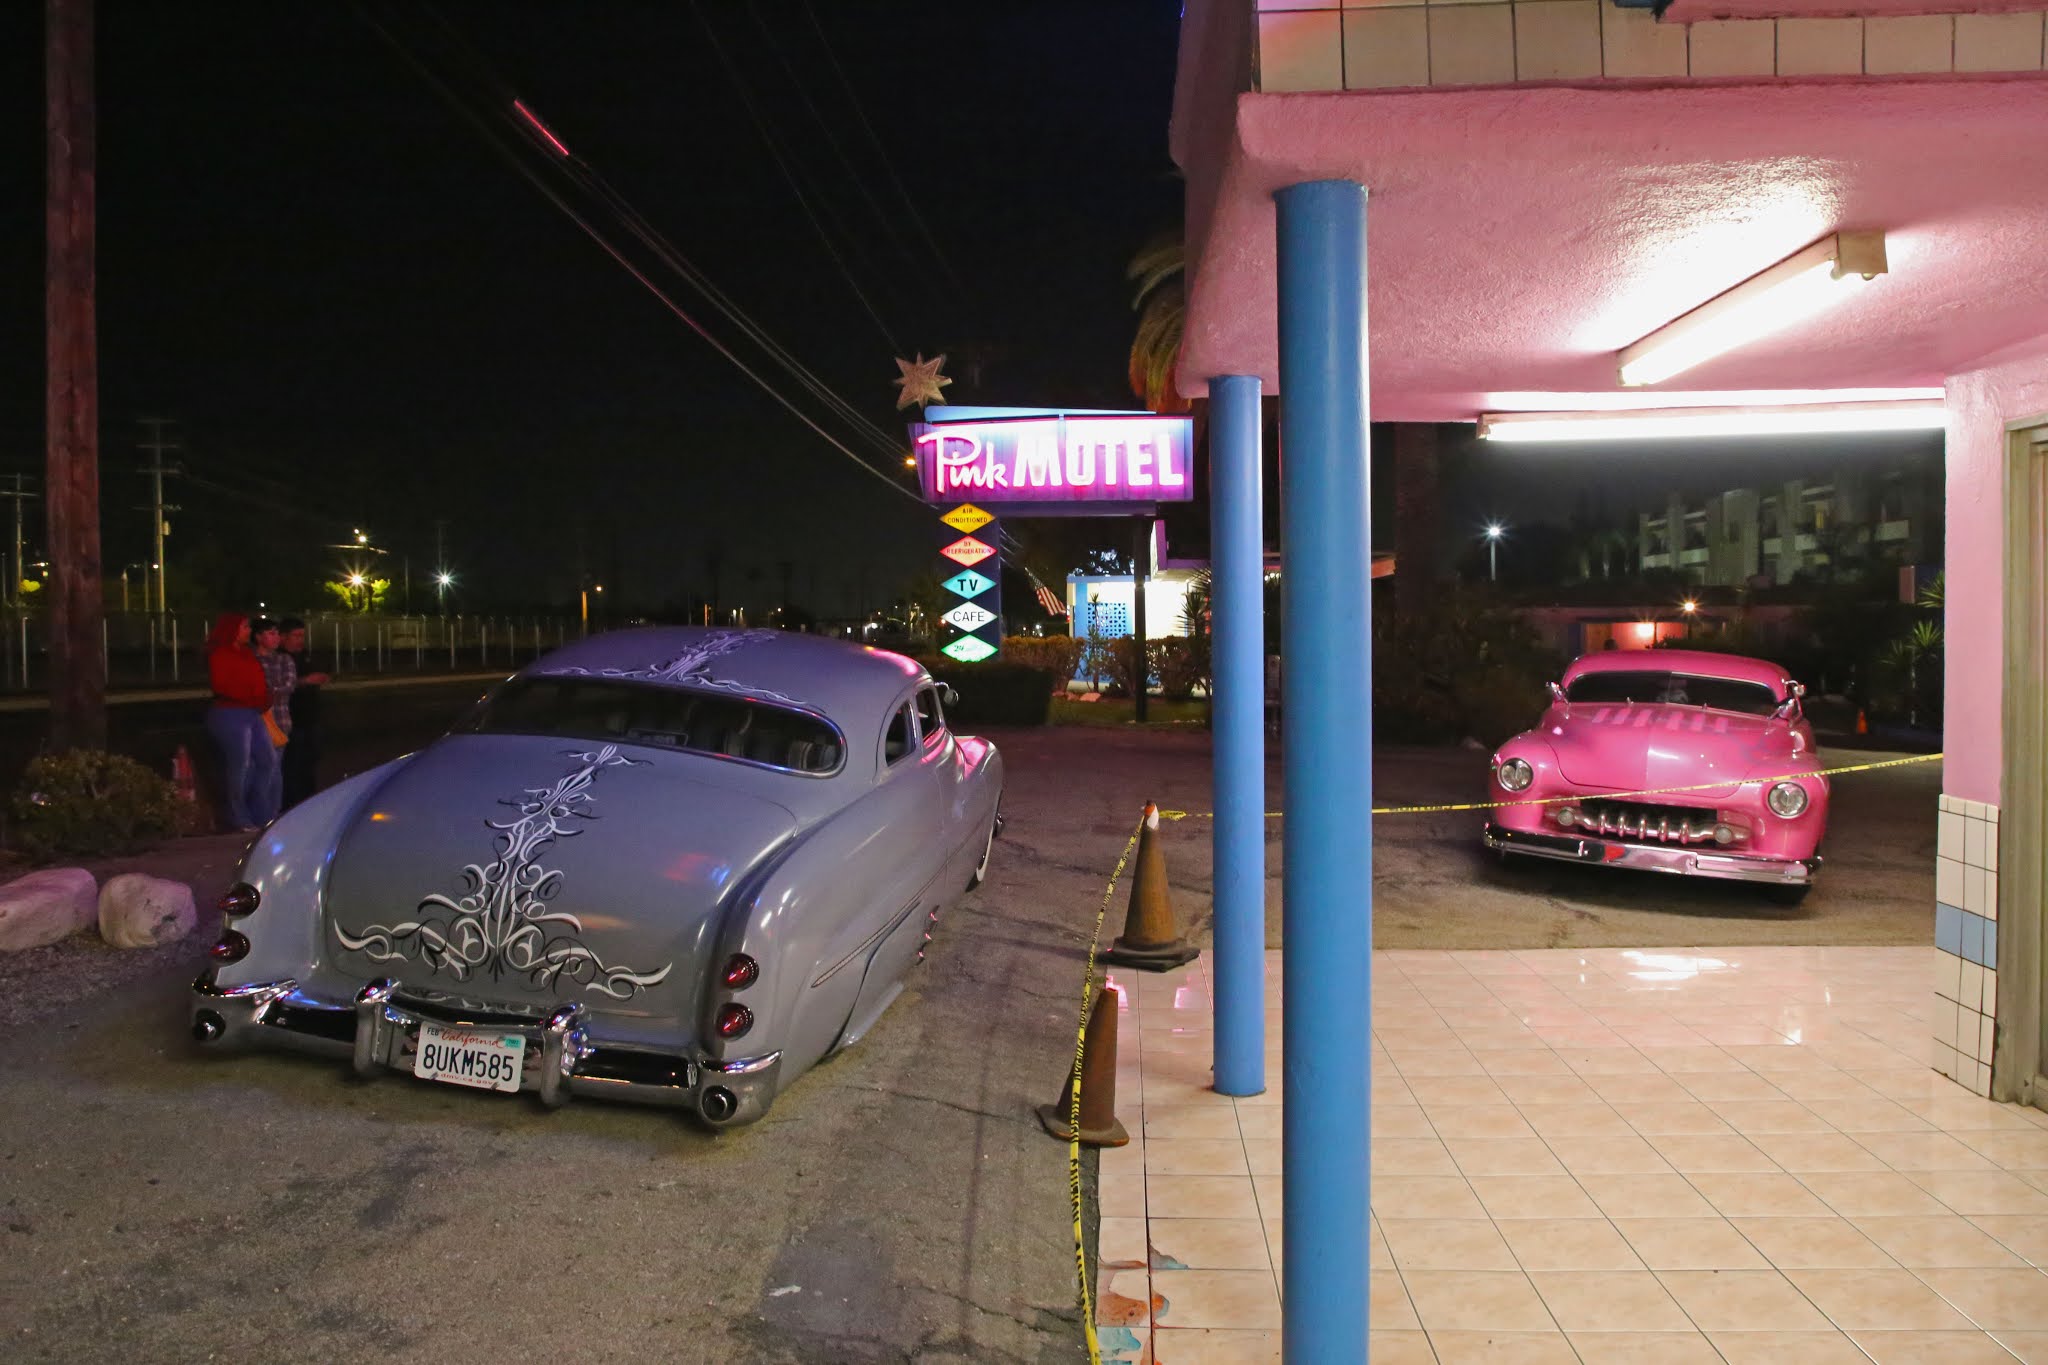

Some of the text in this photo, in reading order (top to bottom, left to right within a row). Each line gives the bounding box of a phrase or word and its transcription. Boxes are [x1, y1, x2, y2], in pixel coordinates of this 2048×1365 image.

[918, 430, 1184, 493] Pink MOTEL
[957, 579, 979, 592] TV
[952, 611, 985, 622] CAFE
[427, 1027, 439, 1036] FEB
[441, 1028, 504, 1048] California
[423, 1043, 514, 1082] 8UKM585
[440, 1073, 494, 1085] dmv.ca.gov
